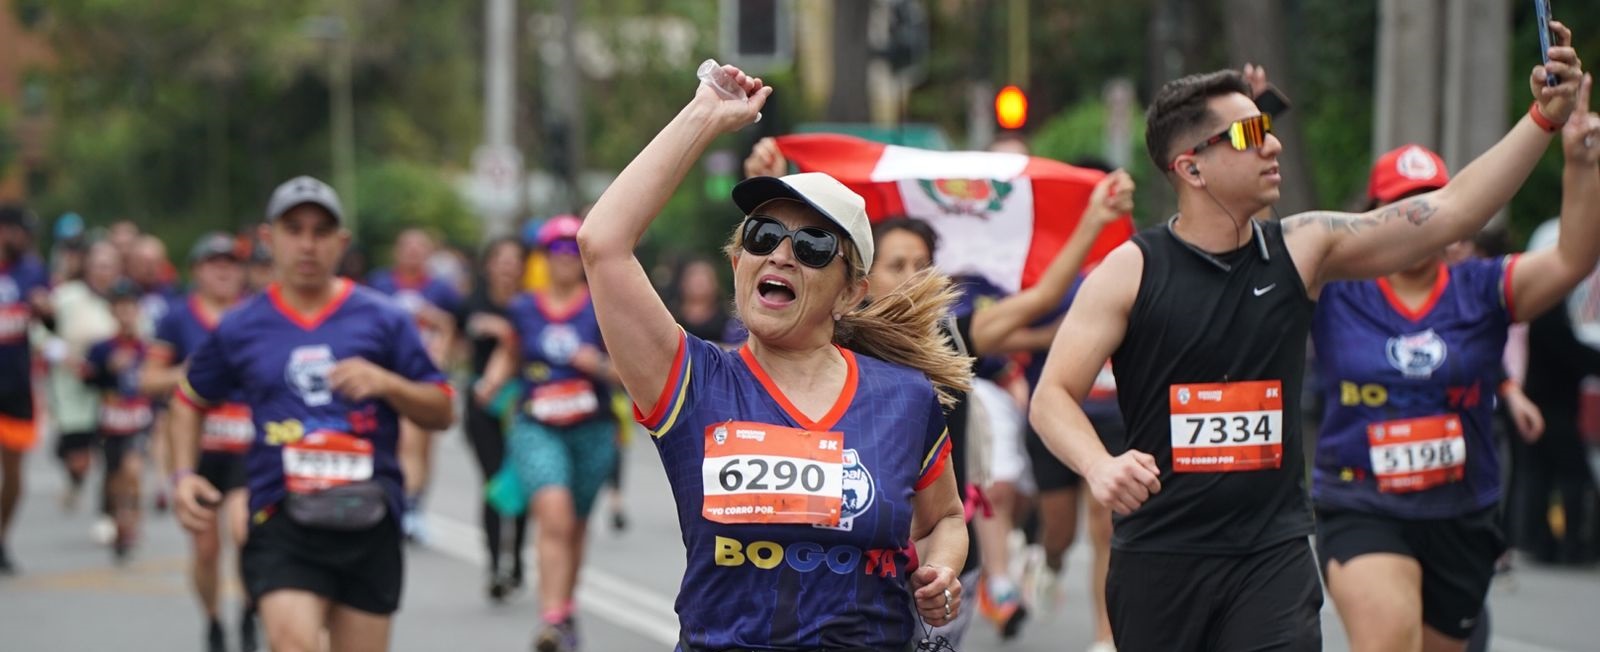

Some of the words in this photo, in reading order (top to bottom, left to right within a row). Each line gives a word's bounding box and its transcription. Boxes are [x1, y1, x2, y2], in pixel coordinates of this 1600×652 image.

[818, 439, 838, 451] 5K
[1186, 414, 1272, 445] 7334
[1384, 439, 1455, 474] 5198
[719, 458, 826, 493] 6290
[724, 506, 754, 515] CORRO
[754, 505, 774, 514] POR
